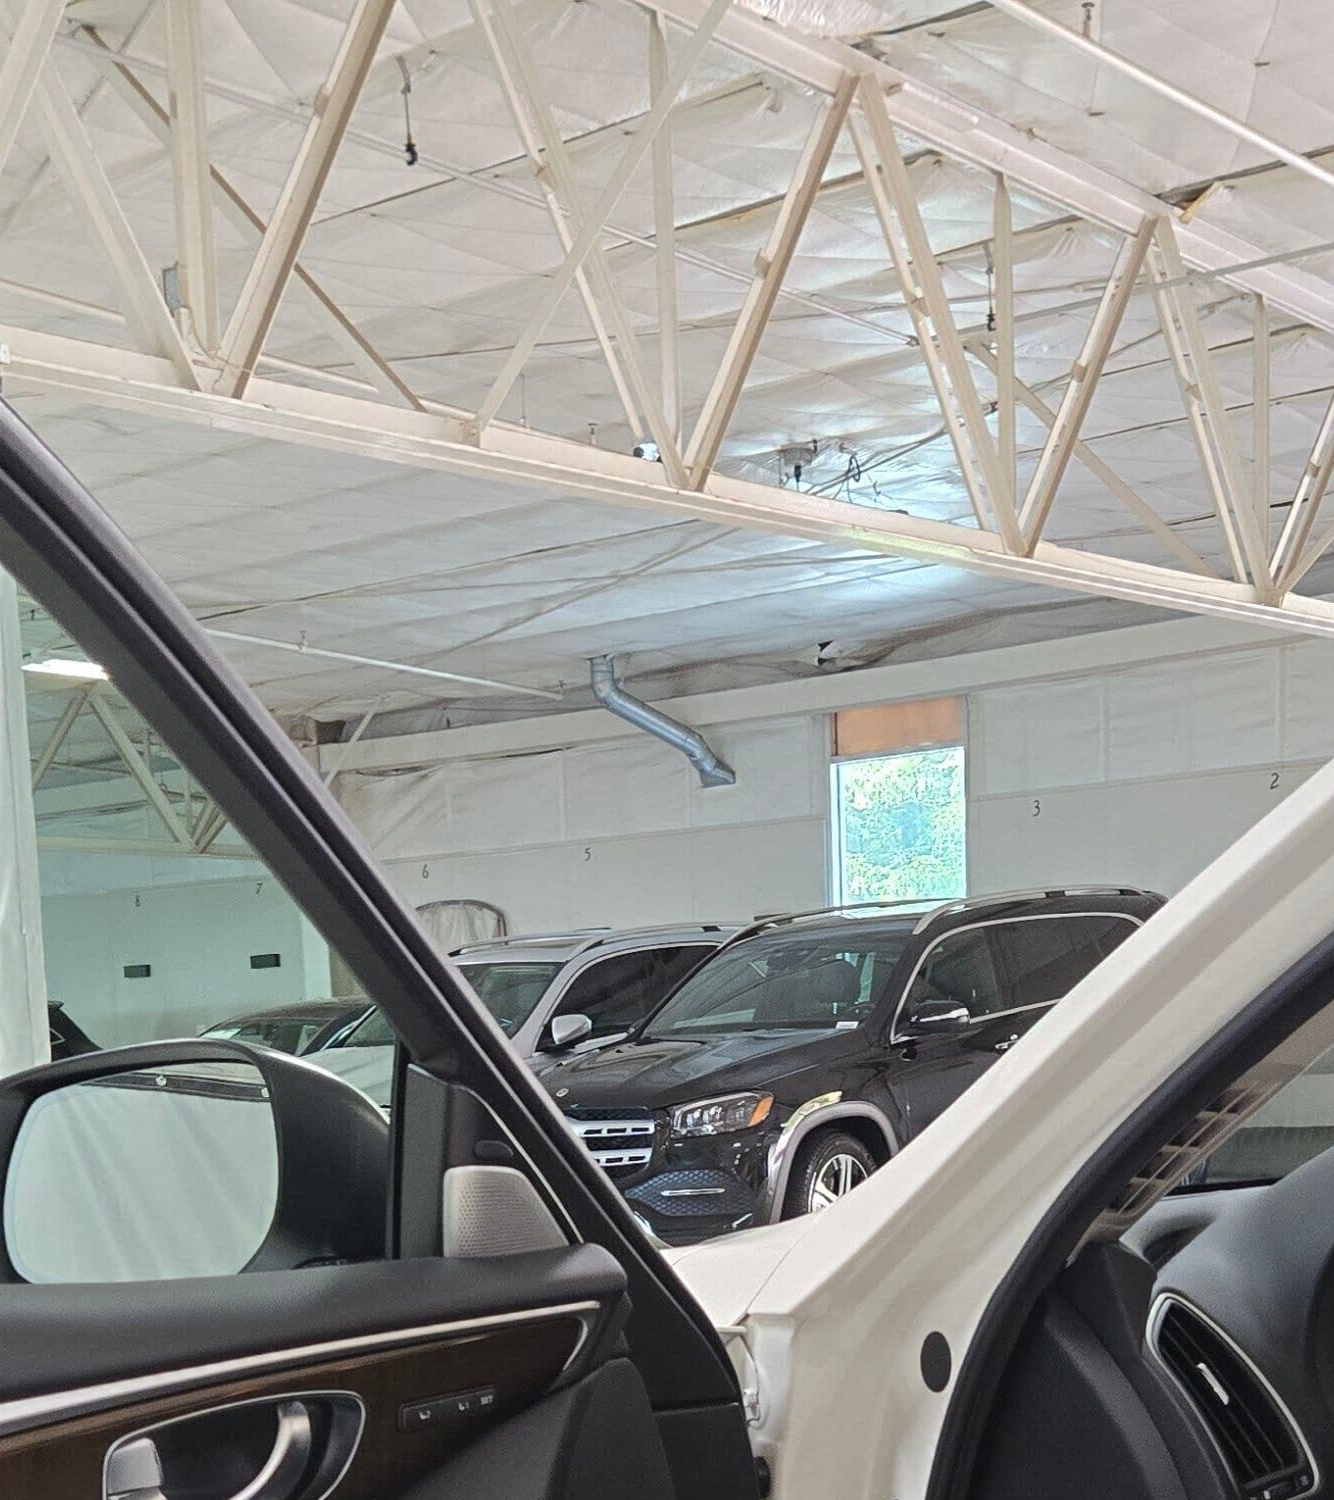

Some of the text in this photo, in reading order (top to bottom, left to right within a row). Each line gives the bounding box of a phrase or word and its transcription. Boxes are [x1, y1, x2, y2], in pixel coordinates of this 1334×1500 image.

[1269, 772, 1280, 789] 2
[1032, 799, 1041, 816] 3
[584, 848, 592, 862] 5
[421, 863, 430, 879] 6
[255, 882, 264, 894] 7
